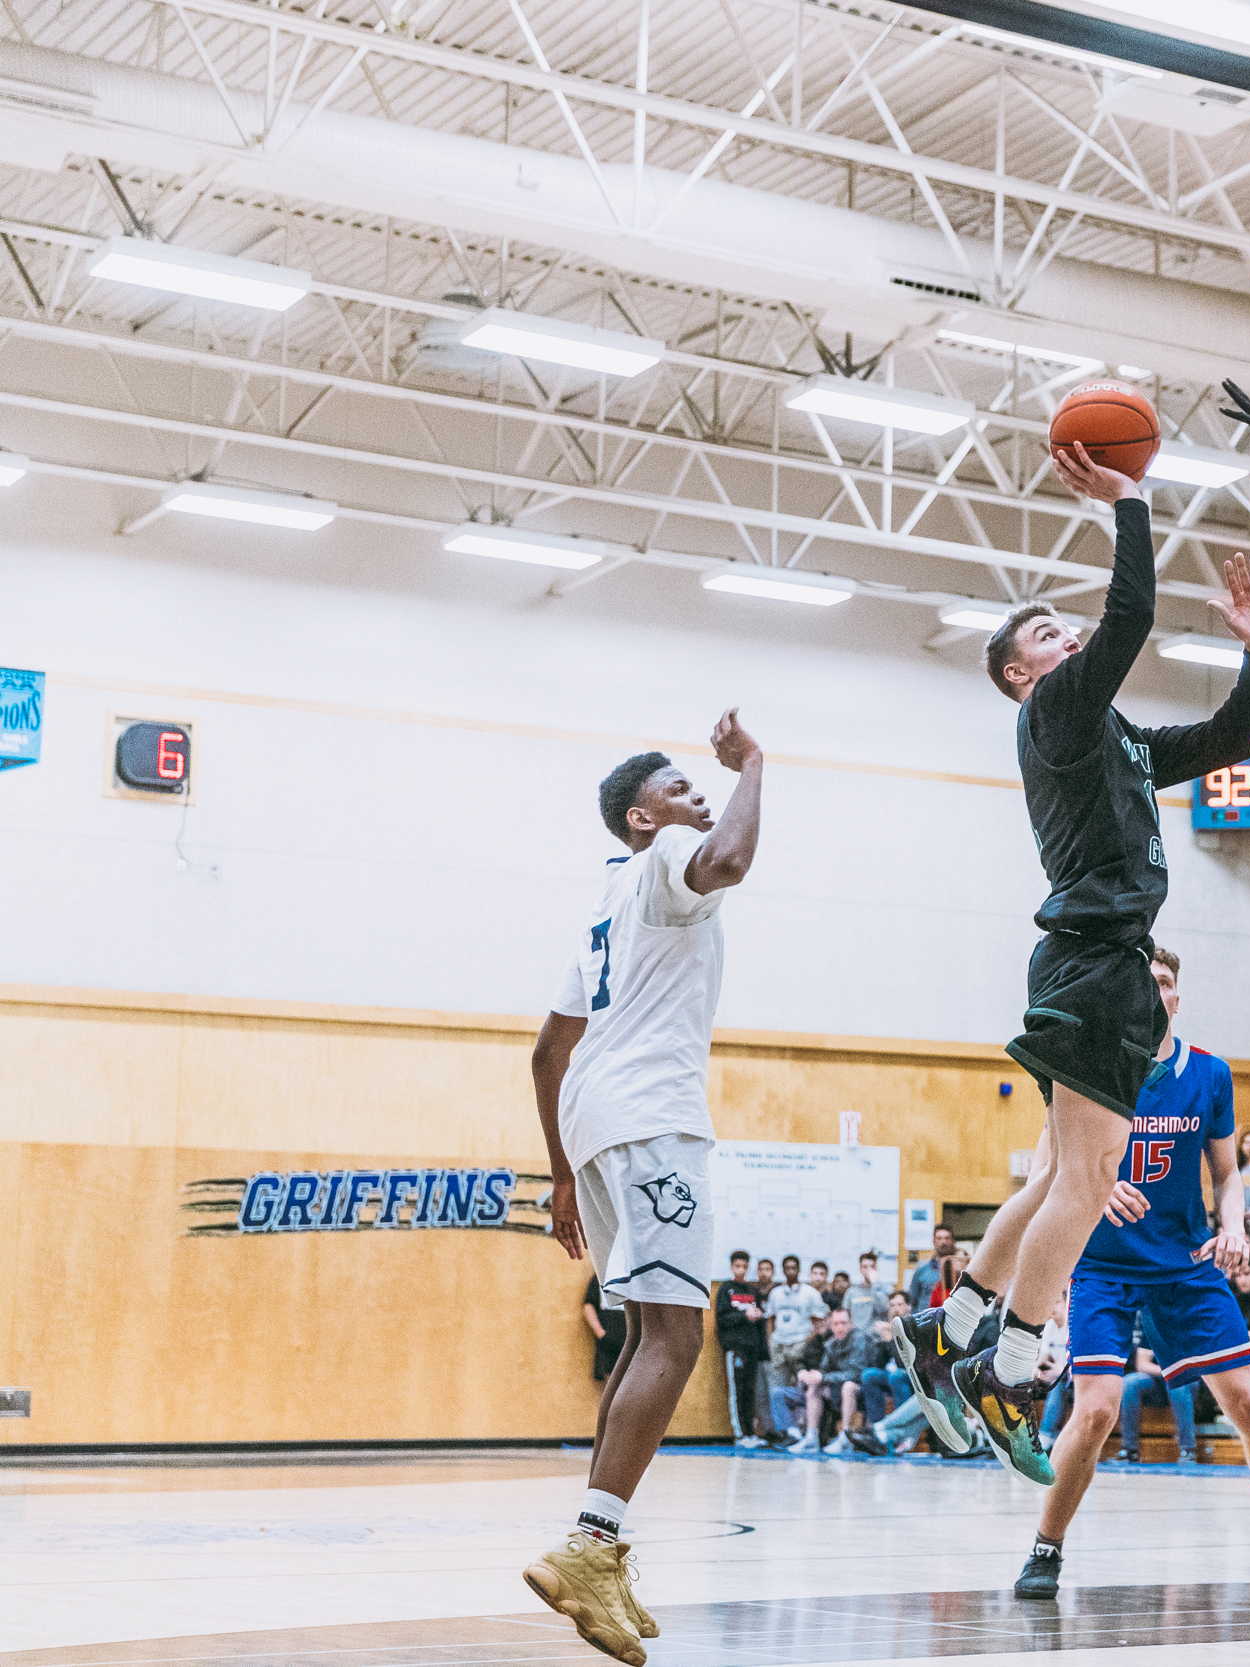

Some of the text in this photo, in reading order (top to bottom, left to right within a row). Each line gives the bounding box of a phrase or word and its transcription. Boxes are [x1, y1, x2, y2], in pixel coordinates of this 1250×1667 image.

[157, 731, 185, 779] 6
[590, 916, 612, 1012] 7
[1130, 1139, 1176, 1184] 15
[239, 1169, 516, 1231] GRIFFINS
